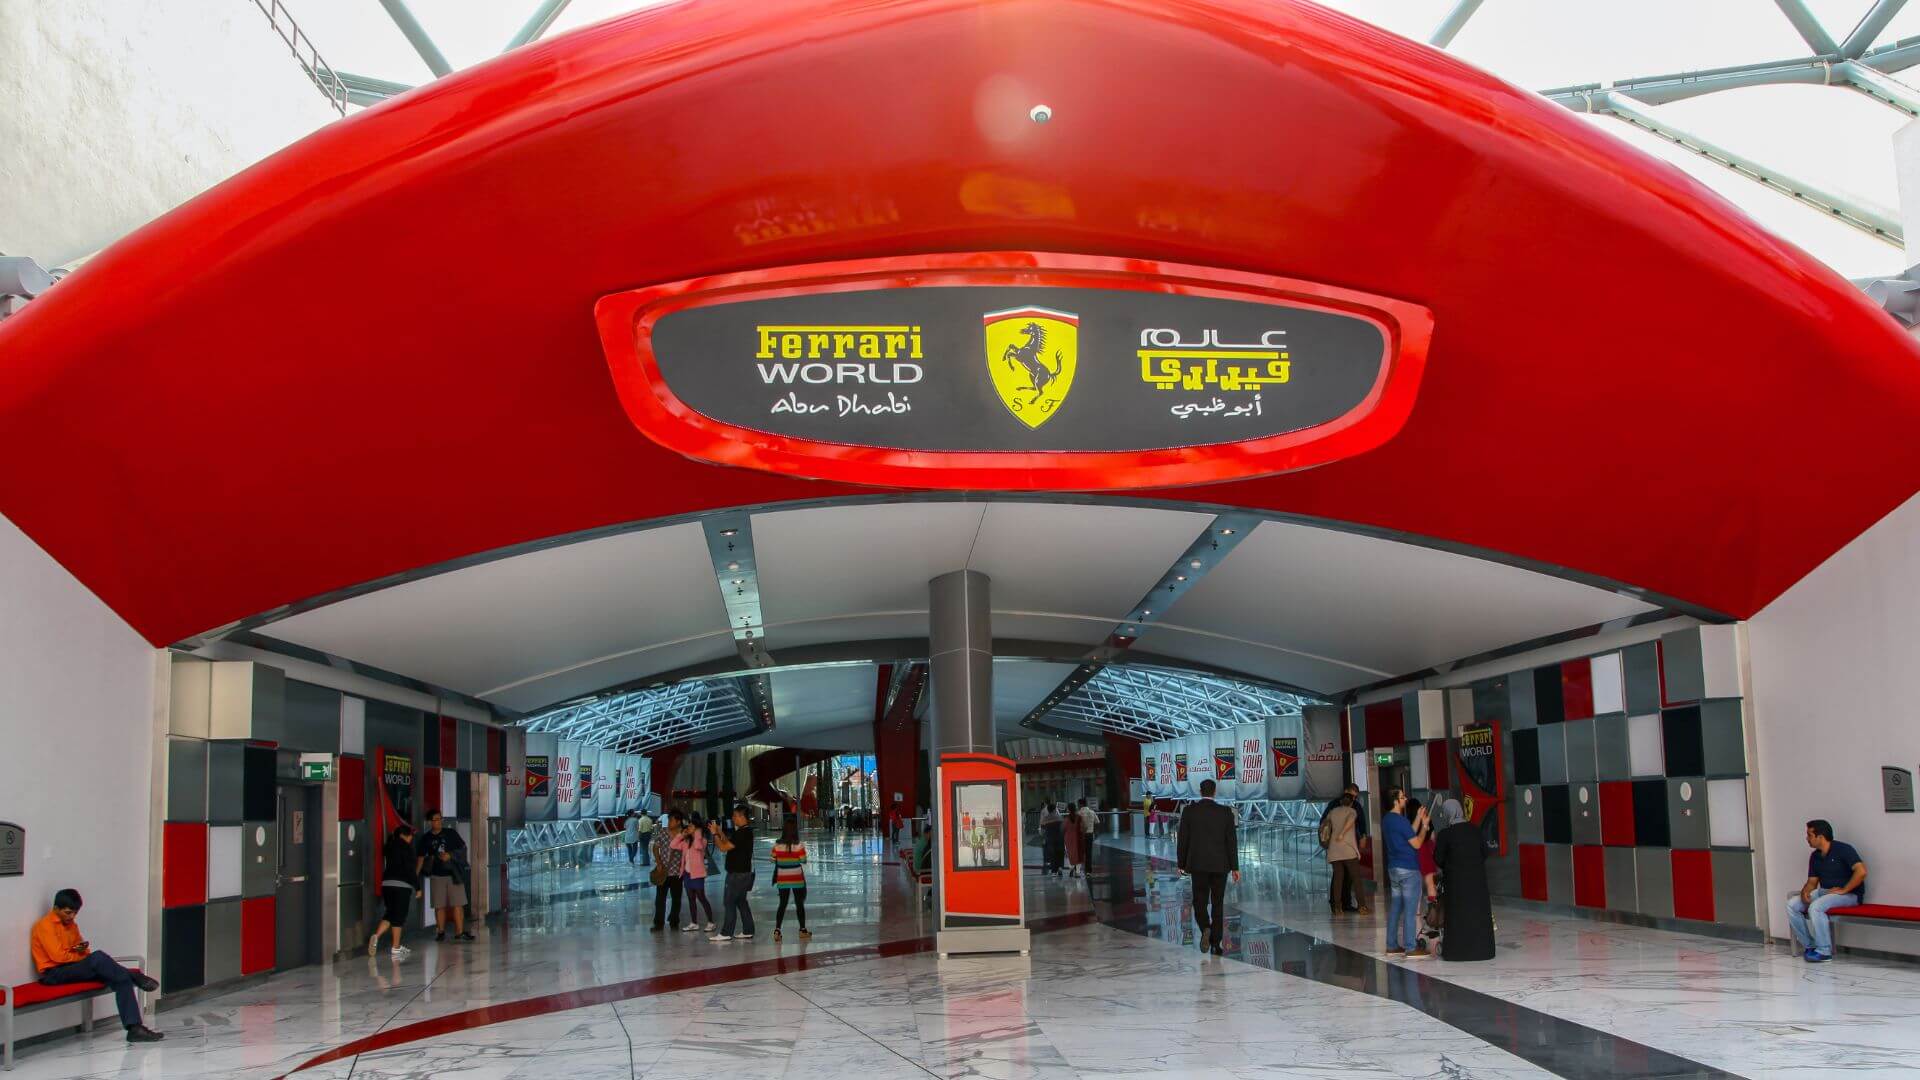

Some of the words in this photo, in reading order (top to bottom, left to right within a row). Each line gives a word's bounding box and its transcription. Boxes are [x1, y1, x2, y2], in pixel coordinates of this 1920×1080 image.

[755, 325, 923, 358] Ferrari
[1140, 328, 1288, 349] عالم
[756, 363, 923, 384] WORLD
[1136, 349, 1291, 391] فيراري
[770, 392, 829, 415] Abu
[837, 392, 912, 417] Dhabi
[1012, 397, 1023, 411] S
[1461, 728, 1492, 747] Ferrari
[1243, 740, 1260, 753] FIND
[1462, 745, 1493, 757] WORLD
[1242, 755, 1262, 768] YOUR
[384, 773, 411, 786] WORLD
[1242, 769, 1264, 784] DRIVE
